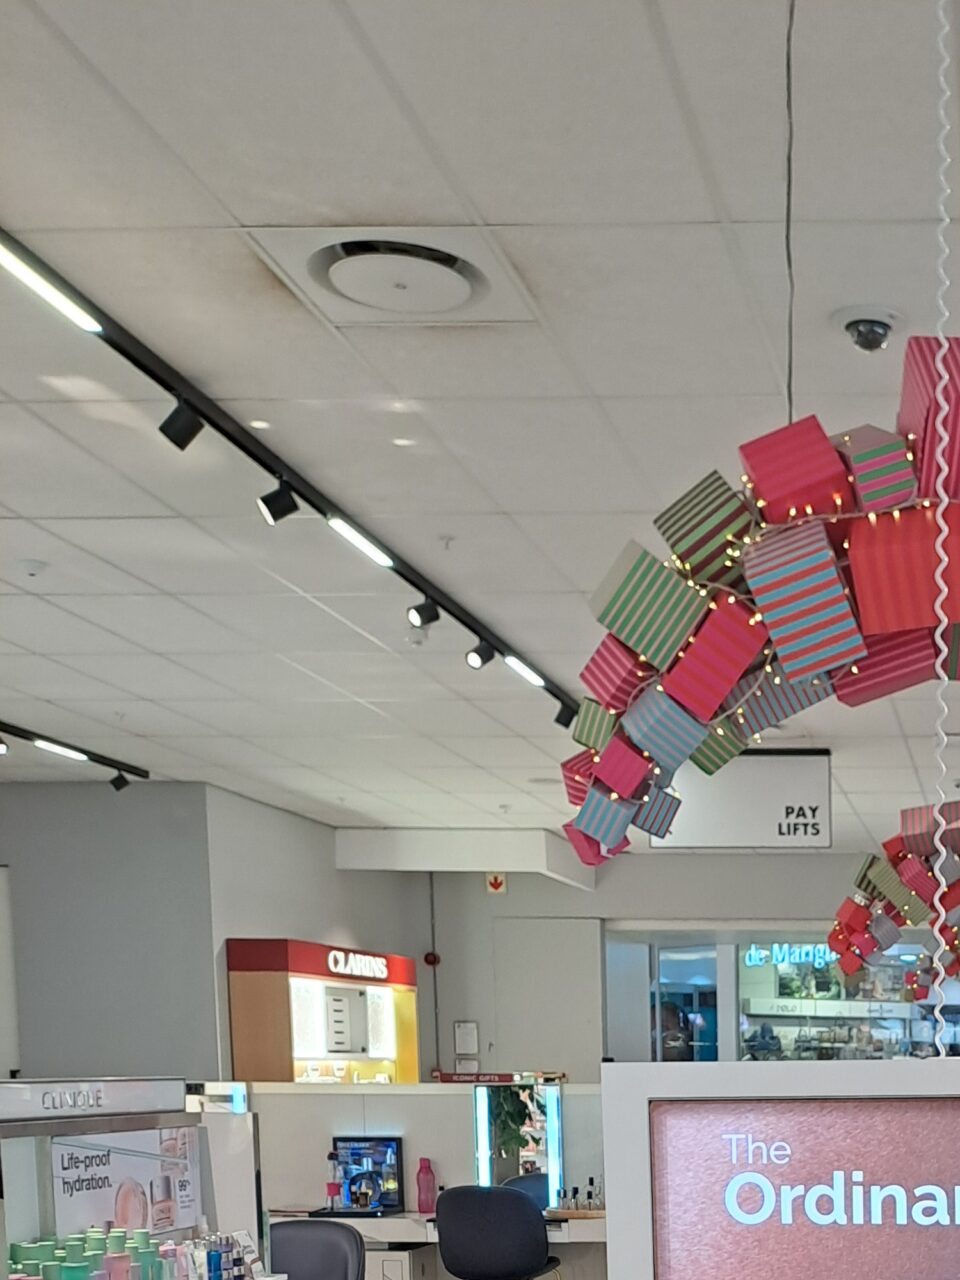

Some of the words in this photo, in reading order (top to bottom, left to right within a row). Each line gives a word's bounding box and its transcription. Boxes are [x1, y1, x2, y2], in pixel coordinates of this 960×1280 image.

[785, 805, 820, 820] PAY
[778, 822, 821, 837] LIFTS
[327, 949, 389, 980] CLARINS
[41, 1088, 103, 1111] CLINIQUE
[721, 1133, 792, 1164] The
[61, 1150, 112, 1172] Life-proof
[62, 1174, 113, 1197] hydration.
